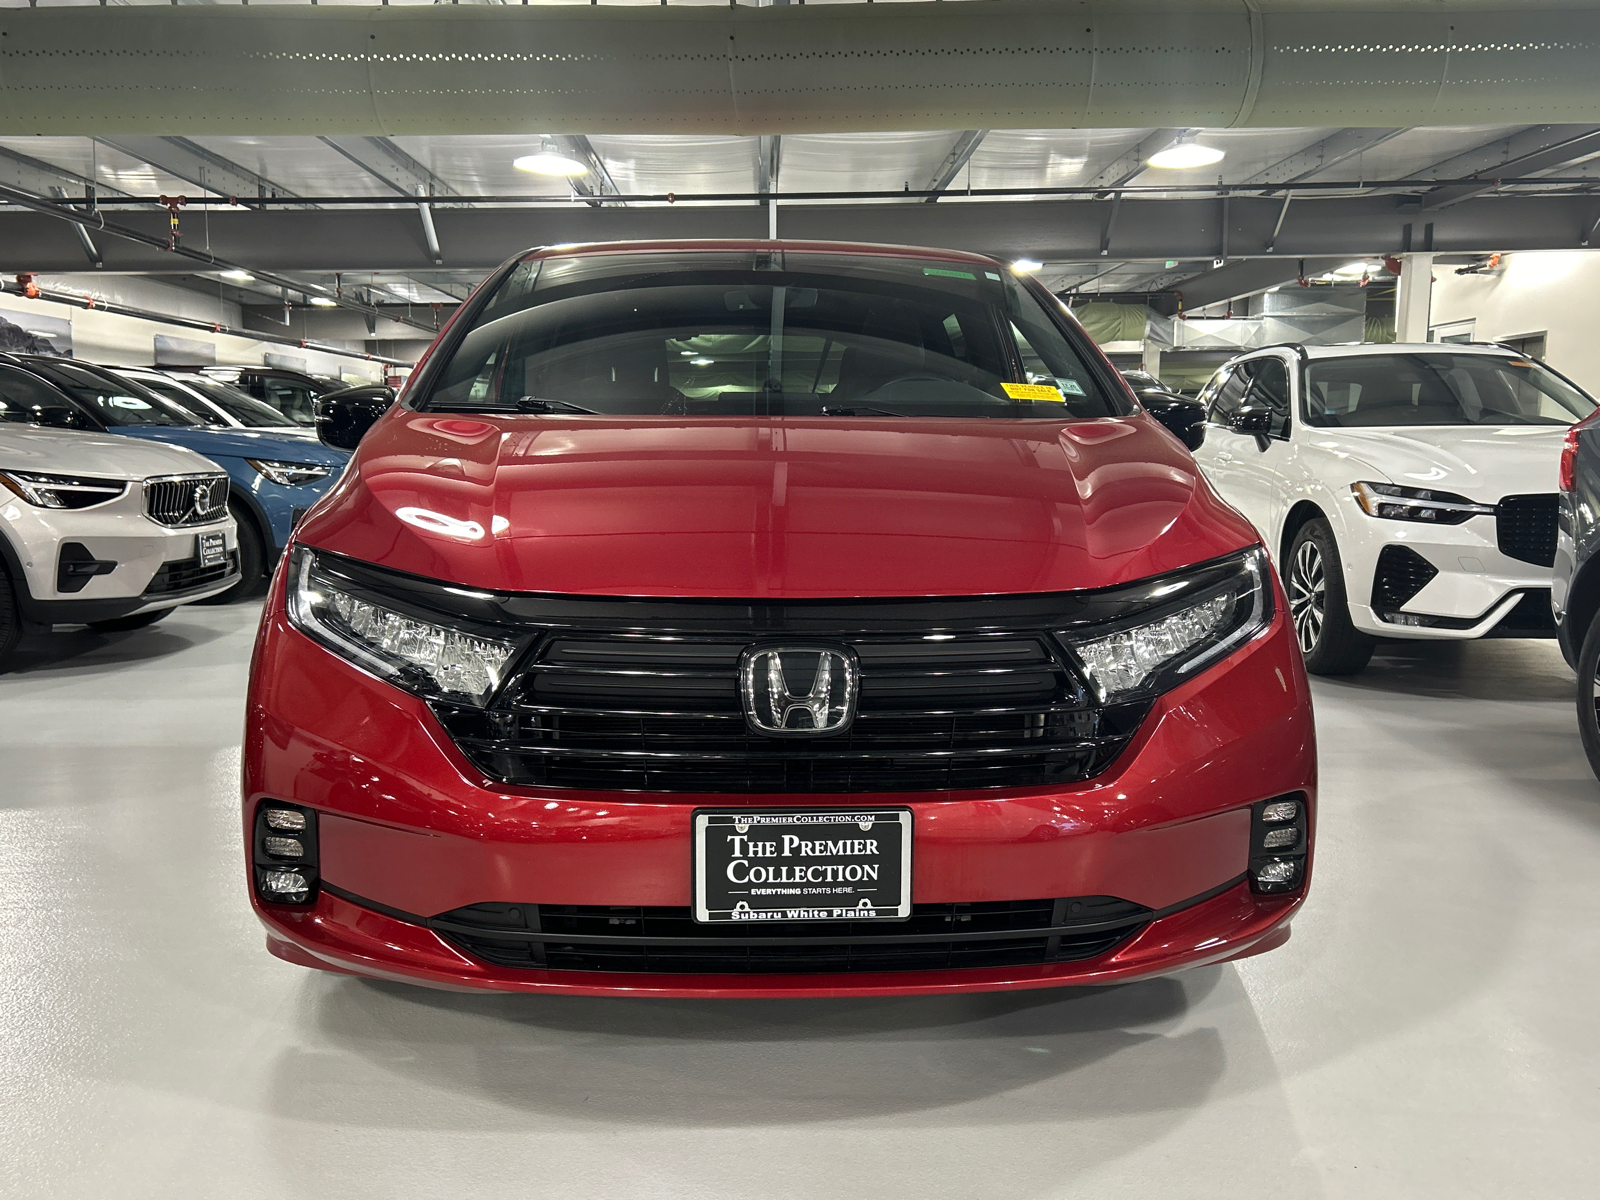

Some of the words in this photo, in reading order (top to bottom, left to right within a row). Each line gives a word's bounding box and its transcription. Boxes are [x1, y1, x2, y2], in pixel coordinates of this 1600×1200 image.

[732, 814, 876, 824] THEPREMIERCOLLECTION.COM
[726, 834, 777, 858] THE
[781, 834, 880, 857] PREMIER
[726, 859, 880, 884] COLLECTION
[751, 887, 801, 895] EVERYTHING
[802, 887, 831, 895] STARTS
[731, 910, 782, 920] Subaru
[786, 909, 828, 919] White
[832, 908, 877, 918] Plains
